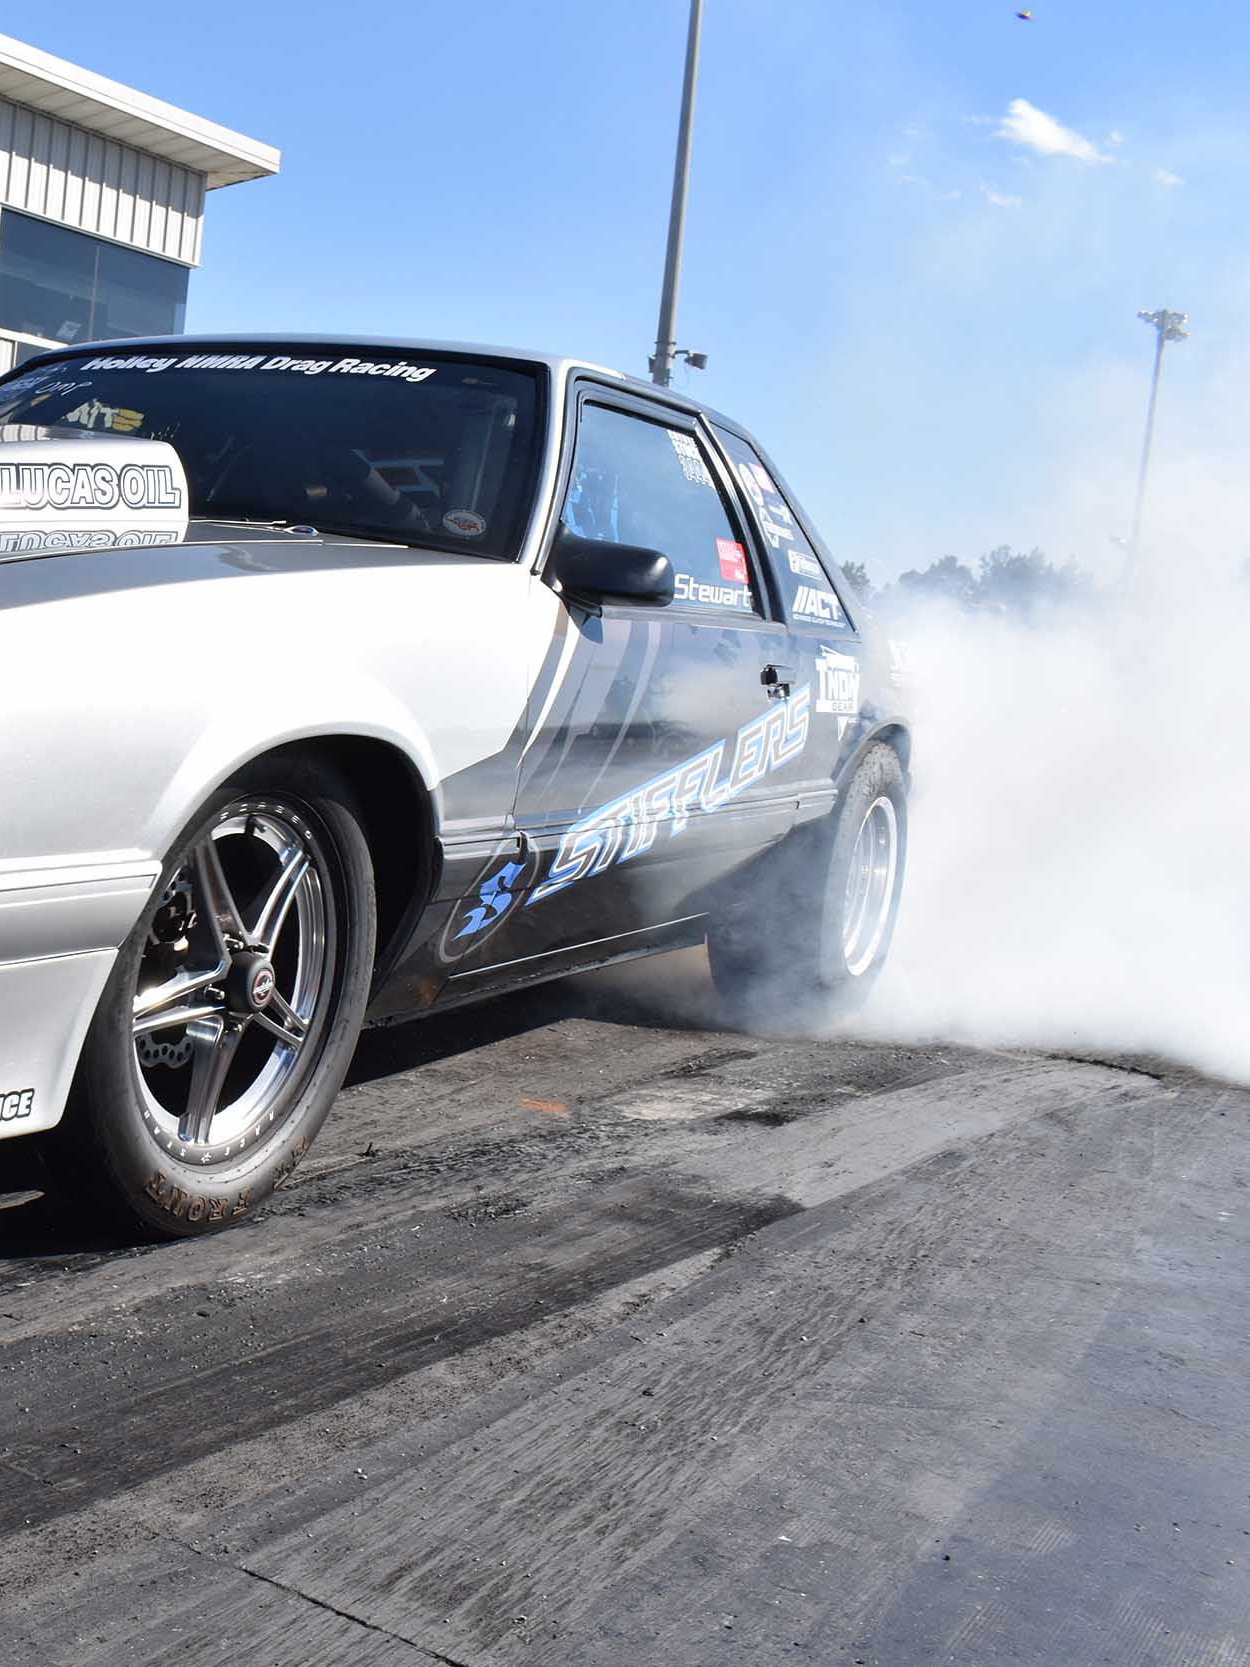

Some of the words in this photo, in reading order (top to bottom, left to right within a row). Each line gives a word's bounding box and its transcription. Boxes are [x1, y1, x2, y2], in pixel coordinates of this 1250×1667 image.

[80, 355, 177, 372] Holley
[175, 354, 259, 370] NMRA
[260, 356, 329, 374] Drag
[329, 358, 437, 382] Racing
[120, 464, 182, 510] OIL
[673, 573, 753, 609] Stewart
[524, 682, 810, 906] STIFFLERS
